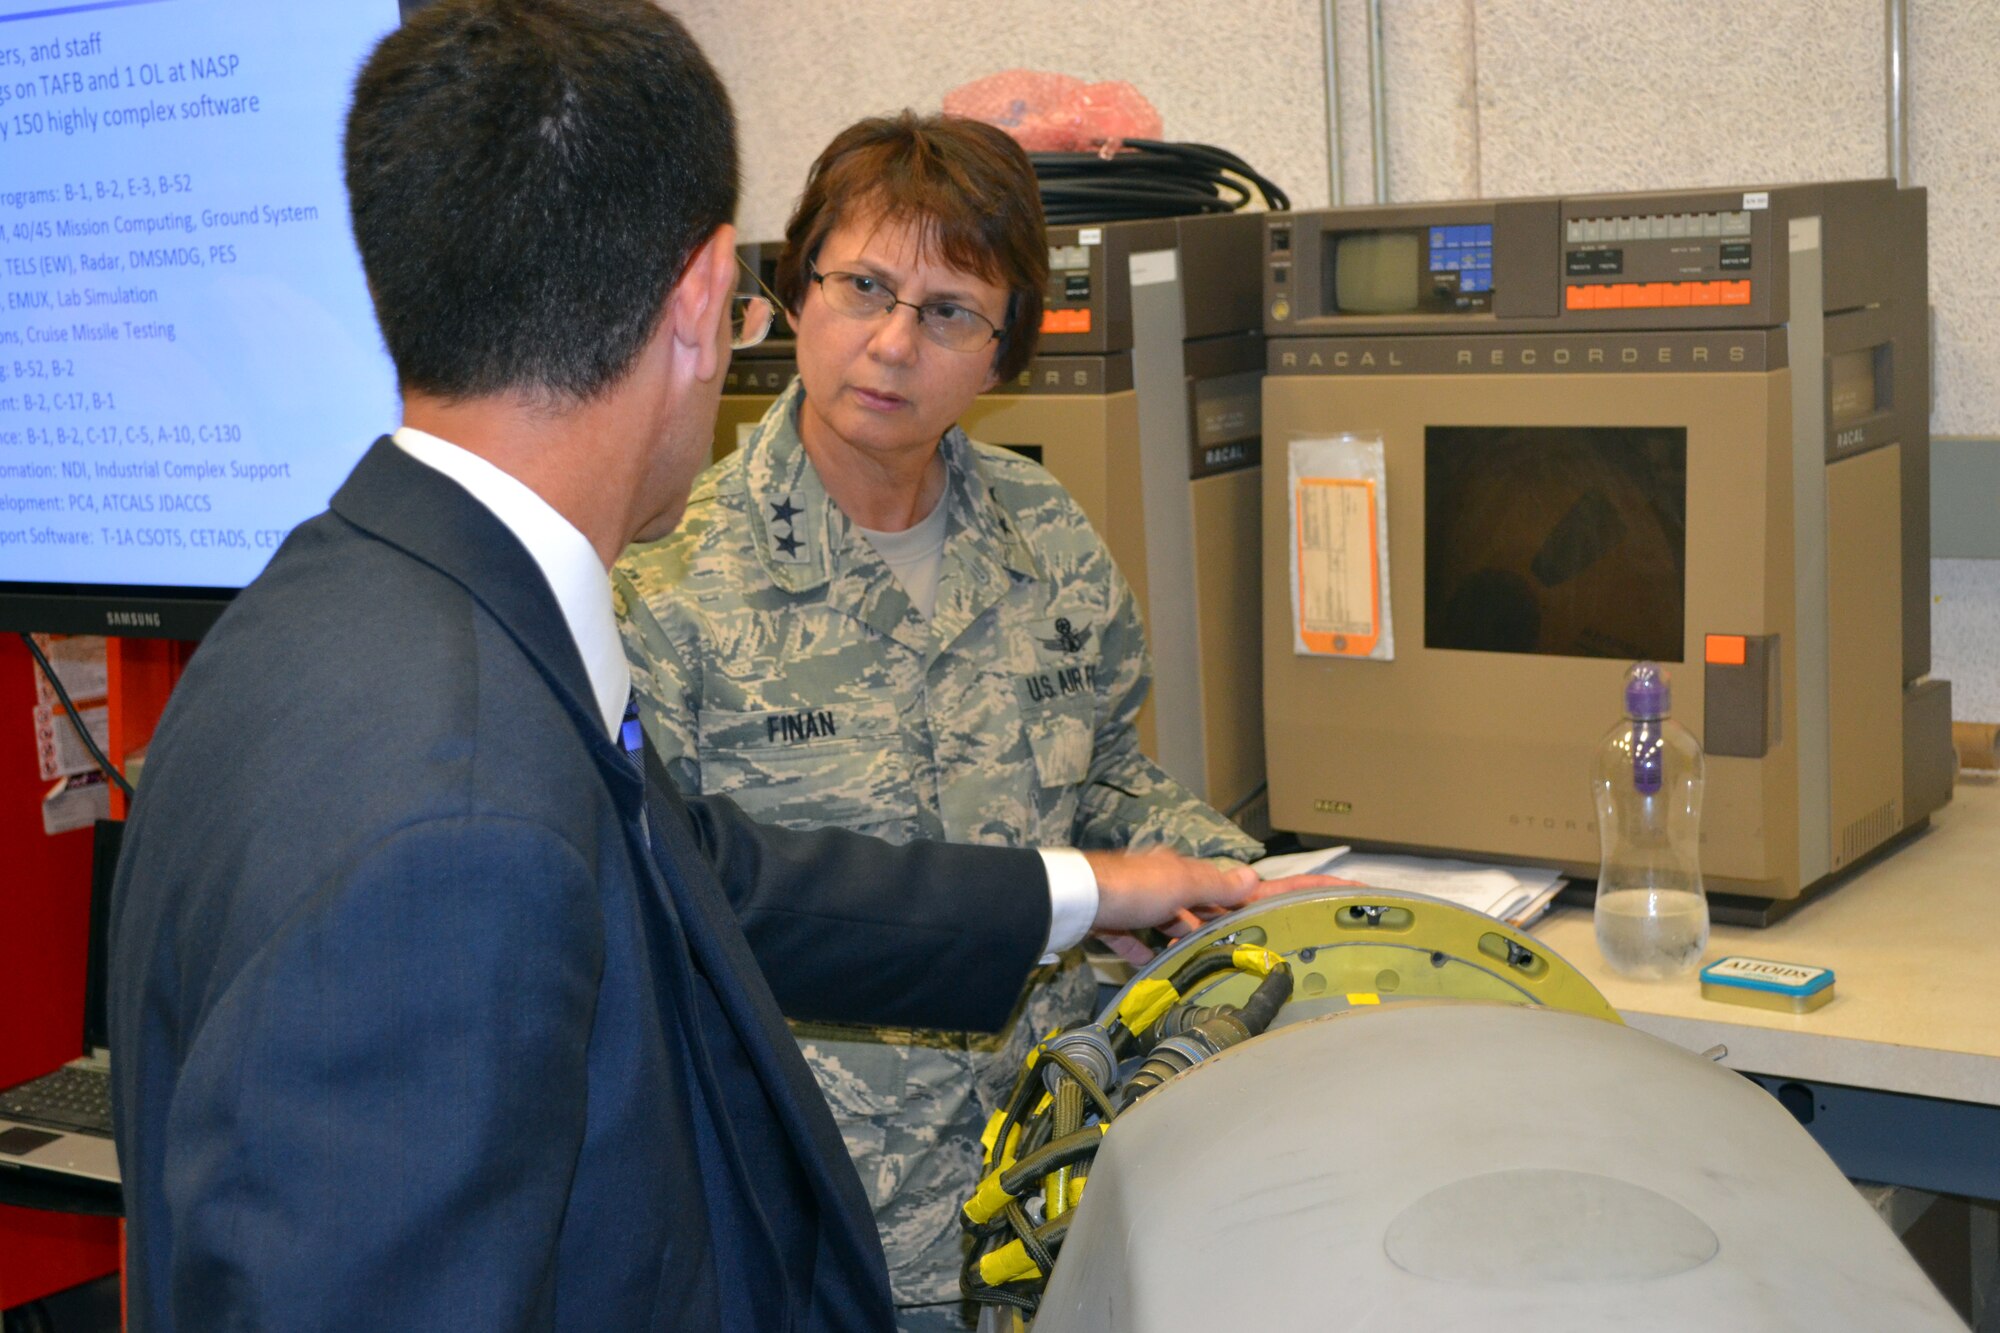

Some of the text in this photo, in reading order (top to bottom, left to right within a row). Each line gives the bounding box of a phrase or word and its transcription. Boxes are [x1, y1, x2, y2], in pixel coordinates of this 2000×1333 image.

[30, 38, 61, 62] and
[65, 31, 101, 58] staff
[15, 82, 36, 100] on
[39, 72, 84, 96] TAFB
[88, 66, 120, 92] and
[125, 66, 135, 87] 1
[139, 64, 164, 86] OL
[169, 64, 186, 83] at
[190, 54, 239, 80] NASP
[13, 112, 43, 136] 150
[48, 107, 98, 136] highly
[103, 99, 177, 128] complex
[181, 94, 260, 119] software
[0, 173, 192, 209] rograms: B-1, B-2, E-3, B-52
[13, 220, 52, 242] 40/45
[56, 218, 110, 237] Mission
[114, 212, 197, 235] Computing,
[201, 207, 259, 228] Ground
[262, 204, 318, 226] System
[5, 258, 37, 276] TELS
[40, 255, 77, 277] (EW),
[80, 252, 125, 272] Radar,
[209, 245, 237, 264] PES
[8, 286, 158, 310] EMUX, Lab Simulation
[26, 325, 68, 343] Cruise
[72, 322, 119, 341] Missile
[123, 321, 176, 342] Testing
[1281, 345, 1746, 367] RACAL RECORDERS
[13, 360, 48, 380] B-52,
[52, 359, 74, 377] B-2
[727, 372, 795, 388] RAC
[23, 394, 50, 413] B-2,
[53, 393, 89, 412] C-17,
[92, 392, 115, 410] B-1
[26, 427, 53, 447] B-1,
[56, 427, 84, 447] B-2,
[86, 426, 121, 446] C-17,
[125, 425, 154, 446] C-5,
[158, 425, 195, 446] A-10,
[199, 424, 241, 443] C-130
[1837, 428, 1864, 449] RACAL
[1205, 446, 1243, 466] RACAL
[61, 461, 91, 480] NDI,
[94, 460, 160, 478] Industrial
[163, 460, 226, 481] Complex
[230, 460, 291, 482] Support
[29, 527, 94, 545] Software:
[101, 527, 134, 546] T-1A
[106, 611, 161, 628] SAMSUNG
[1057, 667, 1085, 695] AIR
[767, 711, 836, 743] FINAN
[1725, 961, 1809, 979] ALTOIDS
